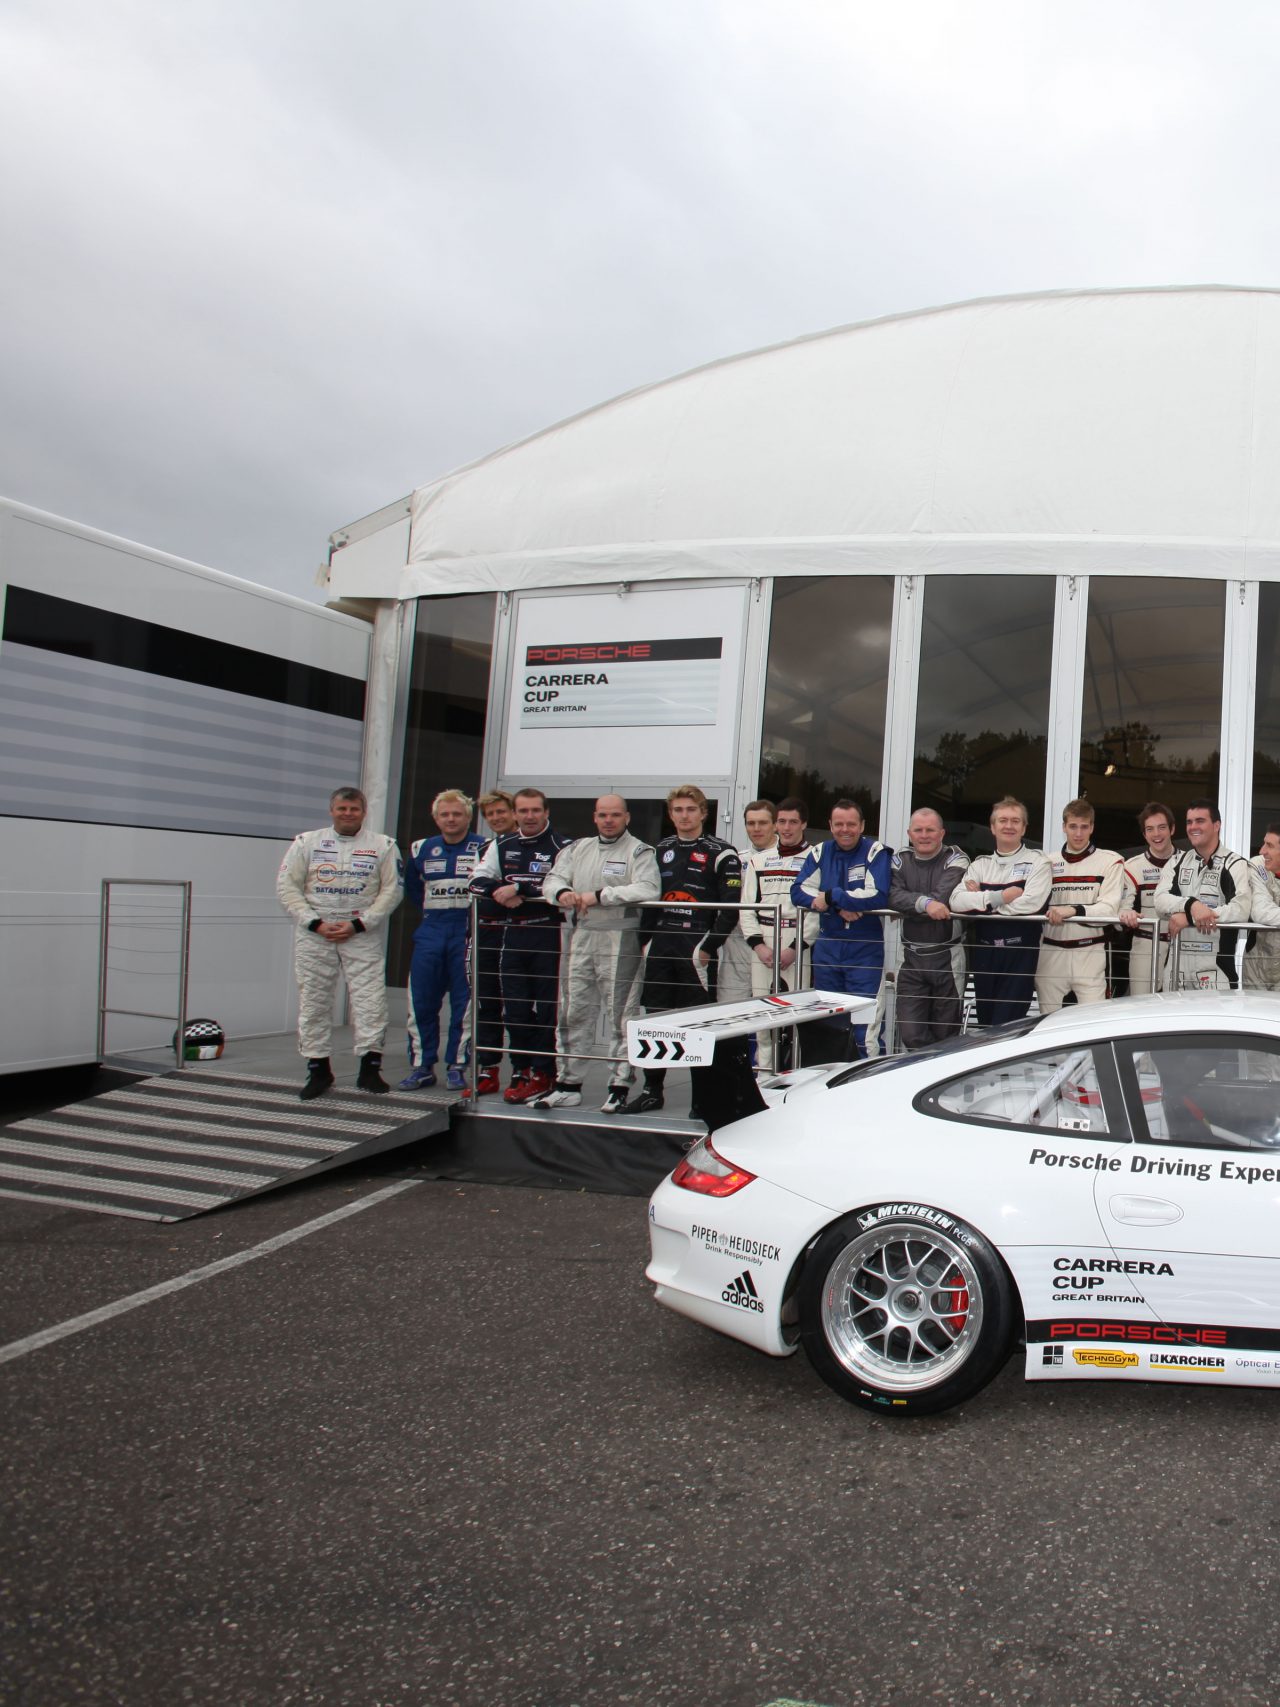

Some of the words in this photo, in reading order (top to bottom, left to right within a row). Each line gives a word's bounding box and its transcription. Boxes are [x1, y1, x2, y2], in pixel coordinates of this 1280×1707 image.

[527, 644, 651, 662] PORSCHE
[525, 673, 609, 688] CARRERA
[524, 690, 560, 703] CUP
[553, 705, 587, 713] BRITAIN
[637, 1028, 687, 1041] keepmoving
[683, 1054, 703, 1063] .com
[1029, 1148, 1122, 1172] Porsche
[1130, 1155, 1212, 1181] Driving
[877, 1204, 954, 1230] MICHELIN
[691, 1224, 718, 1244] PIPER
[729, 1235, 781, 1262] HEIDSIECK
[705, 1243, 723, 1254] Drink
[724, 1248, 764, 1267] Responsibly
[1053, 1257, 1174, 1277] CARRERA
[1052, 1276, 1105, 1290] CUP
[721, 1289, 765, 1314] adidas
[1052, 1293, 1094, 1302] GREAT
[1096, 1294, 1145, 1304] BRITAIN
[1050, 1323, 1227, 1344] PORSCHE
[1160, 1353, 1225, 1367] KÄRCHER
[1235, 1358, 1271, 1368] Optical
